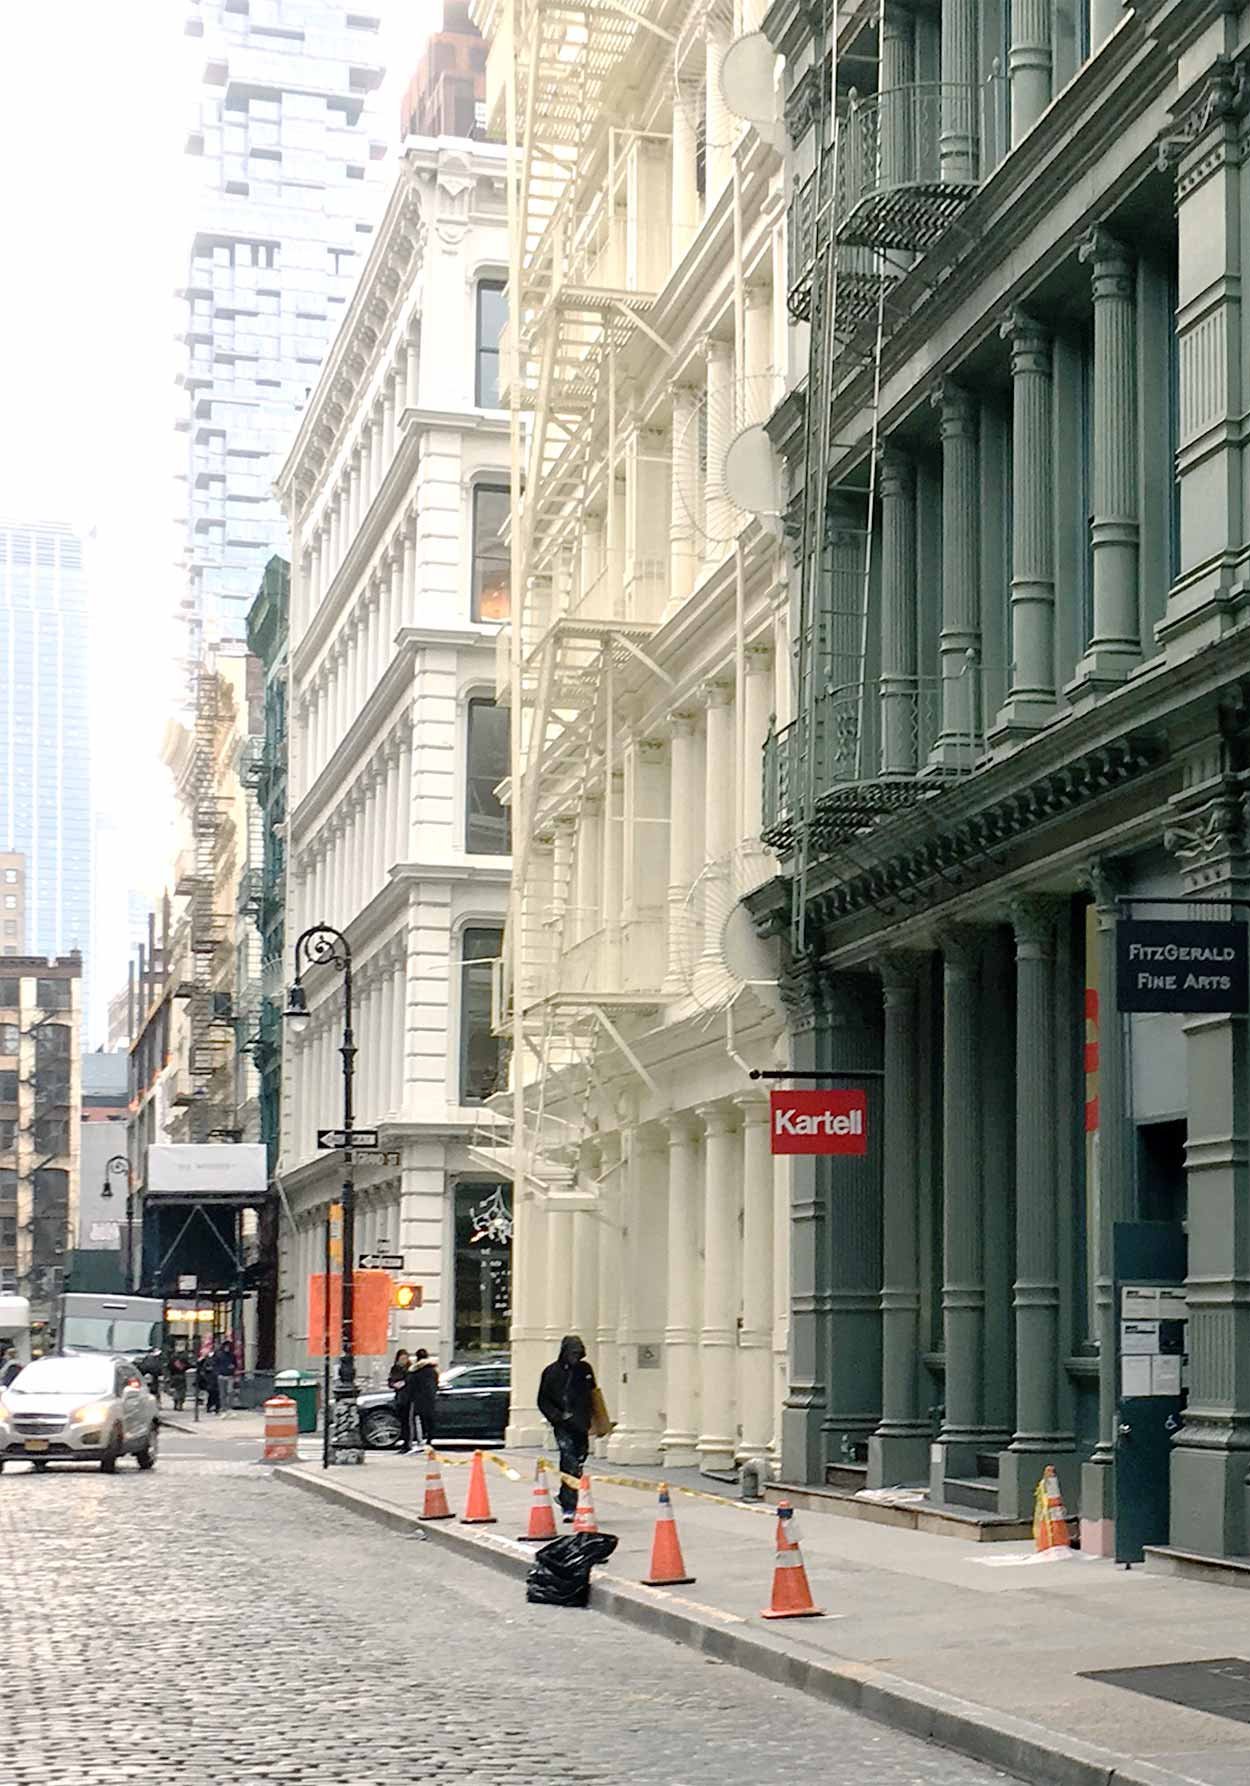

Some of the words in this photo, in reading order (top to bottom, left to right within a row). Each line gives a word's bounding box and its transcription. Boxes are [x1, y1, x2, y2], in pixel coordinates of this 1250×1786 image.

[1137, 972, 1177, 990] FINE
[1183, 972, 1231, 990] ARTS
[775, 1109, 862, 1135] Kartell
